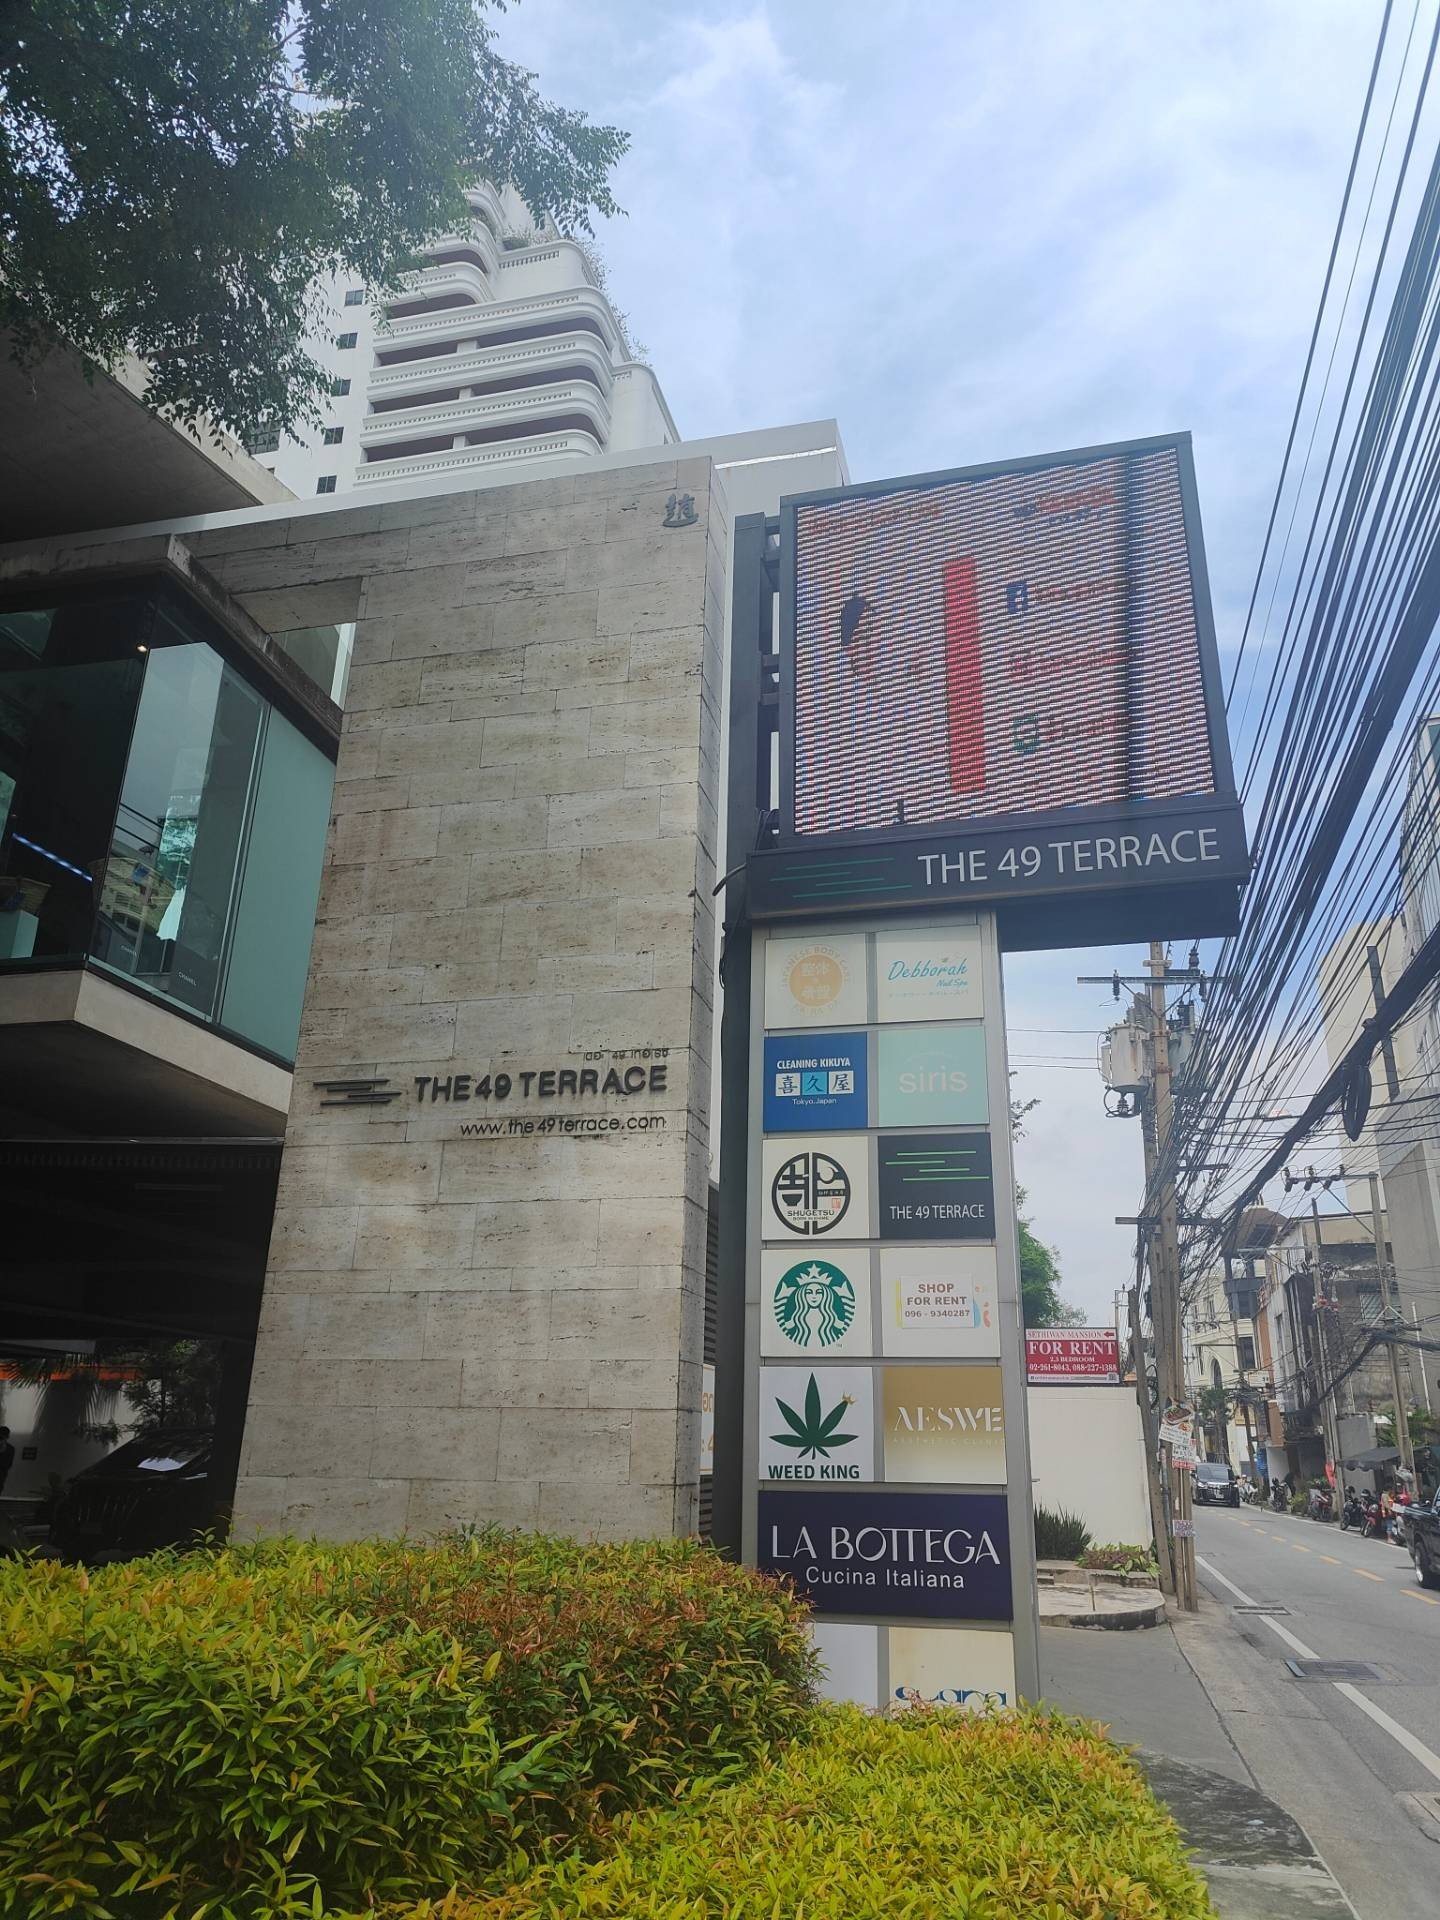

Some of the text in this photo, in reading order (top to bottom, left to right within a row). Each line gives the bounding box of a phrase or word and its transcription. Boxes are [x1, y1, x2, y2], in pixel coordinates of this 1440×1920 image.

[918, 828, 1221, 886] THE 49 TERRACE
[888, 957, 968, 981] Debborah
[777, 1057, 851, 1070] CLEANING KIKUYA
[518, 1065, 668, 1097] TERRACE
[778, 1074, 852, 1095] 喜久屋
[899, 1066, 968, 1093] siris
[787, 1209, 835, 1217] SHUGETSU
[890, 1204, 985, 1219] THE 49 TERRACE
[918, 1283, 954, 1293] SHOP
[907, 1296, 967, 1306] FOR RENT
[1068, 1330, 1102, 1339] MANSION
[1029, 1341, 1115, 1355] FOR RENT
[768, 1465, 860, 1479] WEED KING
[772, 1525, 1001, 1565] LA BOTTEGA
[806, 1567, 965, 1589] Cucina Italiana
